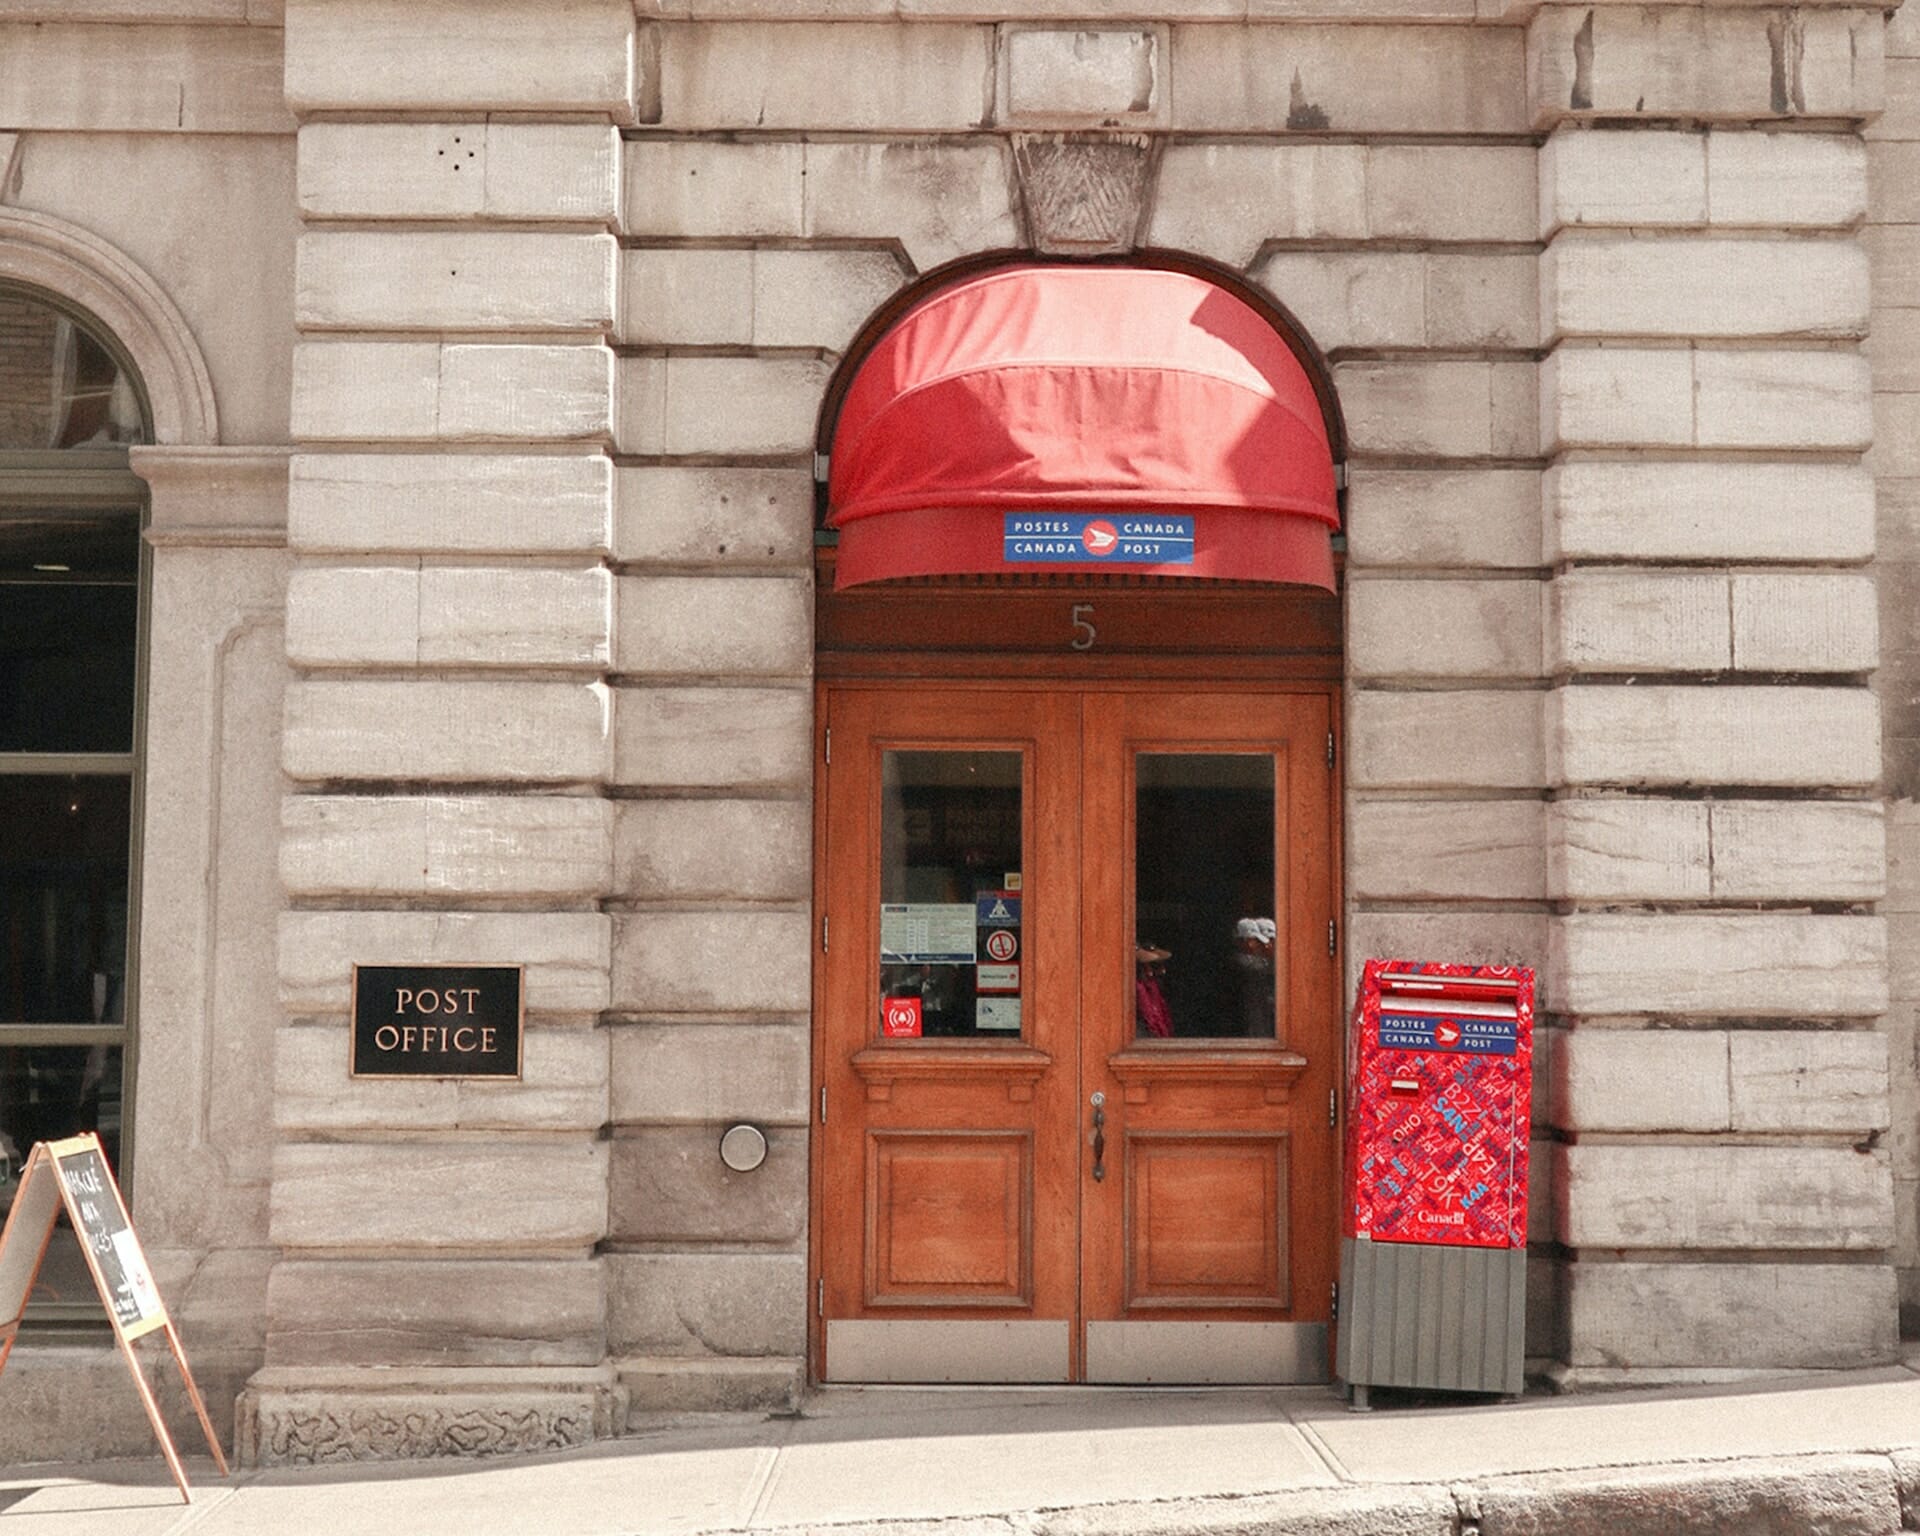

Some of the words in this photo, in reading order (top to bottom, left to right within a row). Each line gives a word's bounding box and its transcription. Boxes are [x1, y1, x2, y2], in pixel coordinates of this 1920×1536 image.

[1014, 522, 1070, 532] POSTES
[1123, 523, 1185, 534] CANADA
[1014, 543, 1077, 553] CANADA
[1123, 544, 1161, 554] POST
[1071, 604, 1096, 650] 5
[395, 988, 480, 1014] POST
[1385, 1019, 1426, 1029] POSTES
[1464, 1024, 1511, 1034] CANADA
[374, 1025, 497, 1053] OFFICE
[1385, 1035, 1431, 1045] CANADA
[1464, 1039, 1492, 1048] POST
[1418, 1210, 1465, 1225] Canada
